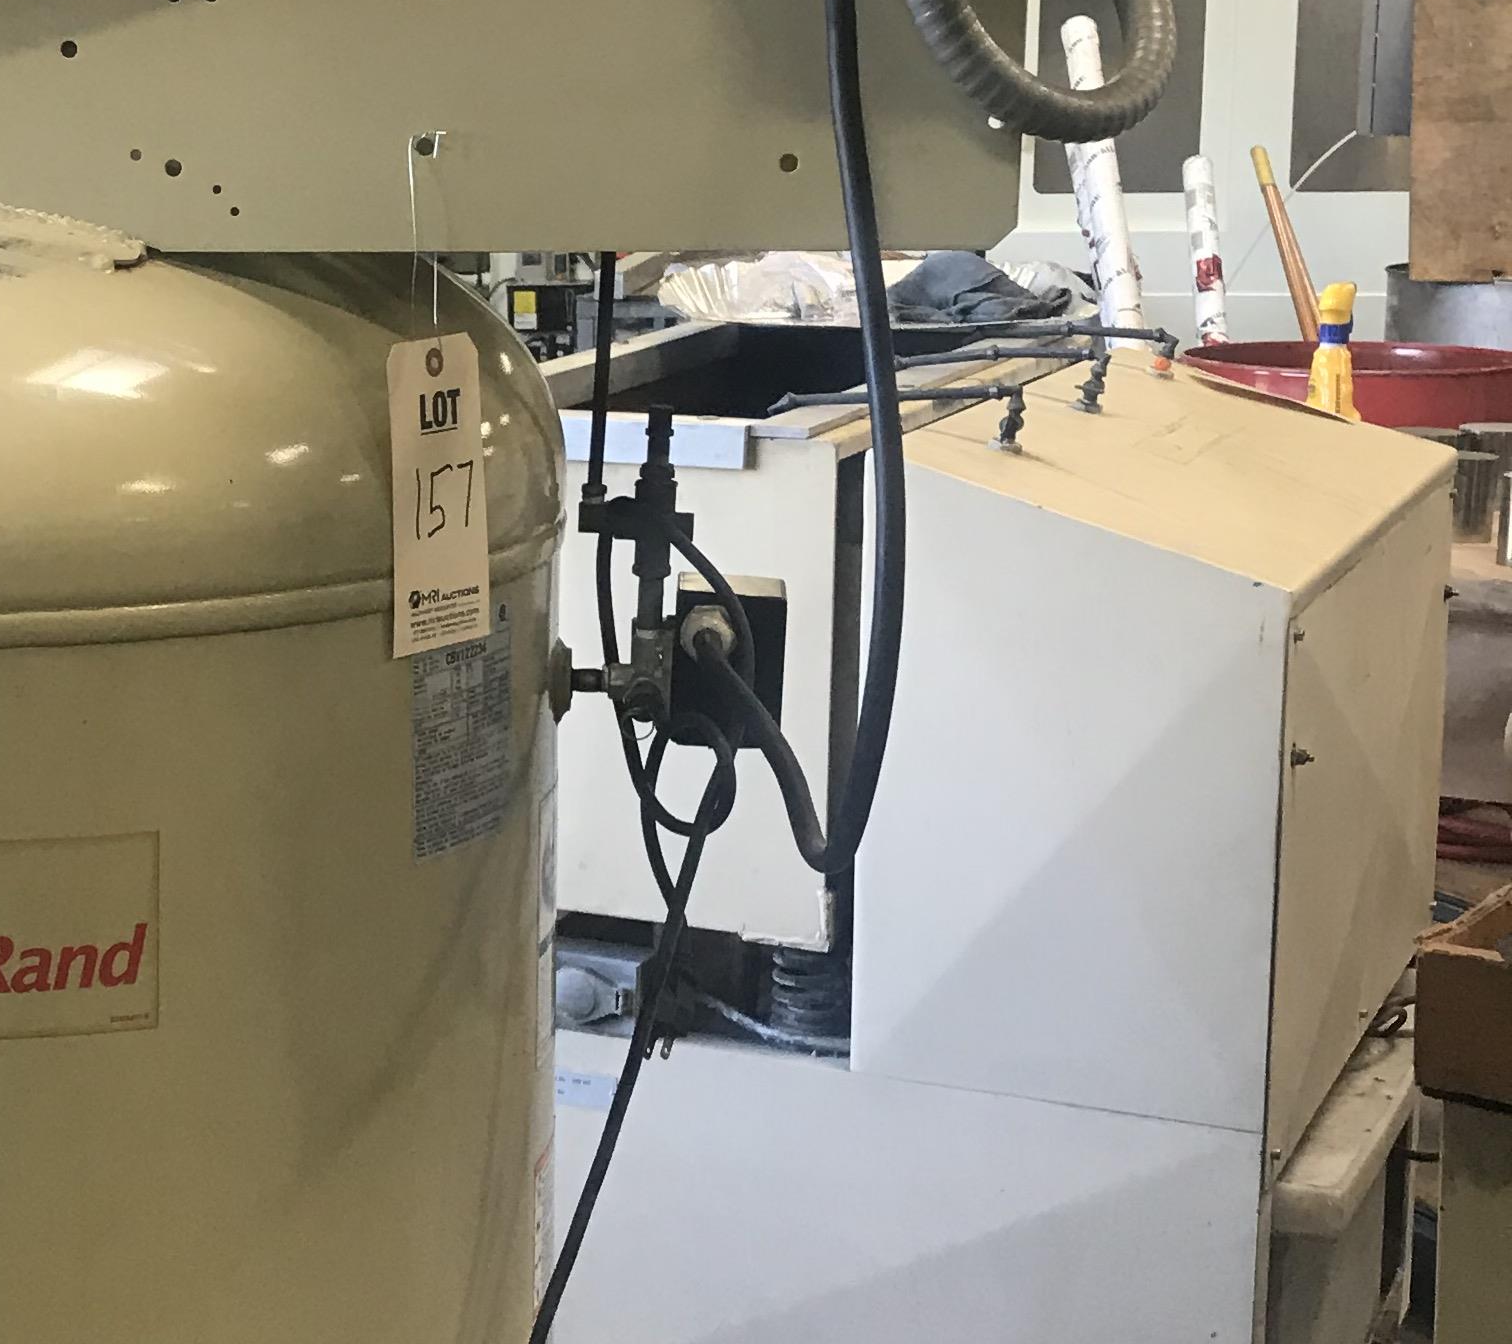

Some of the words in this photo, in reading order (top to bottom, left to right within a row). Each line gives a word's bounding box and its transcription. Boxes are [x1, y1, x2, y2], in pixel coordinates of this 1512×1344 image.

[419, 388, 461, 431] LOT
[416, 461, 474, 540] 157
[441, 585, 480, 602] AUCTIONS
